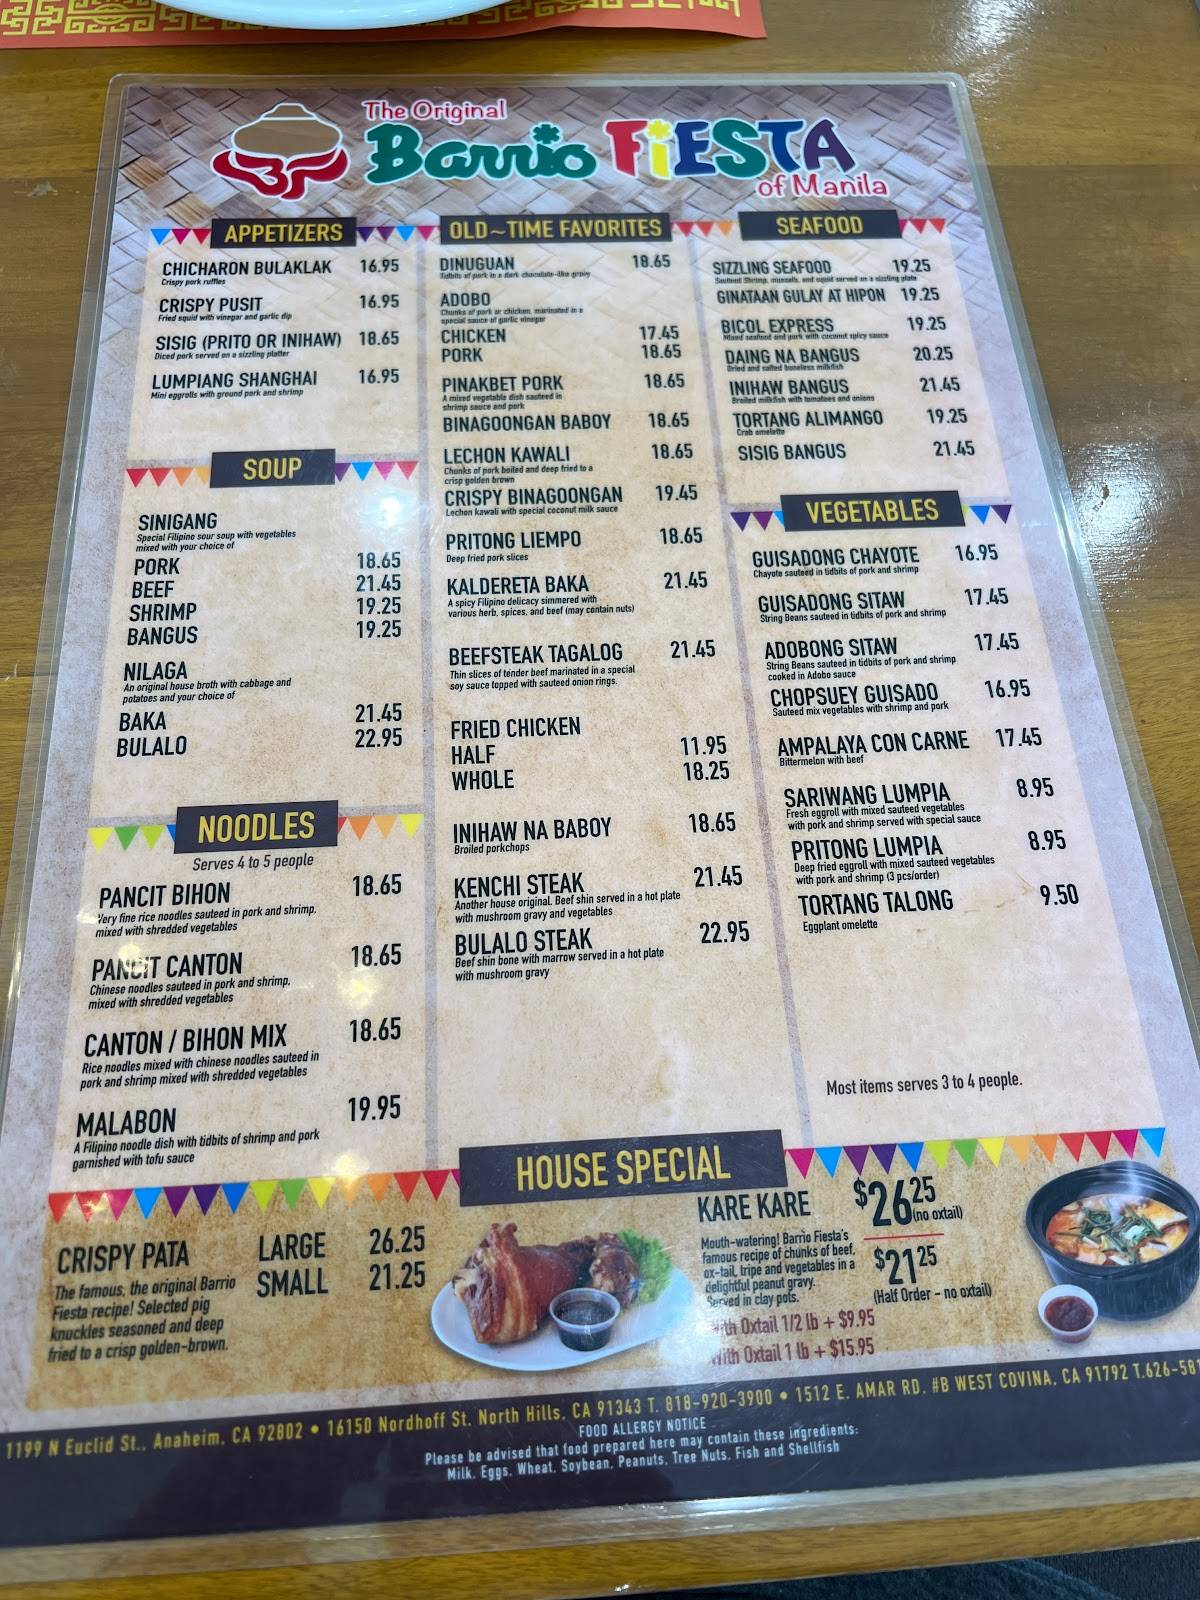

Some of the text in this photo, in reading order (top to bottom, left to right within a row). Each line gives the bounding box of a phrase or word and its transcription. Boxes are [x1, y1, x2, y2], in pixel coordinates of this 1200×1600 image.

[364, 100, 506, 123] The Original
[367, 123, 597, 184] Barrio
[758, 173, 888, 196] of Manila
[224, 223, 342, 242] APPETIZERS
[559, 218, 661, 237] FAVORITES
[776, 216, 862, 234] SEAFOOD
[162, 260, 331, 276] CHICHARON BULAKLAK
[360, 258, 399, 272] 16.95
[440, 256, 514, 271] DINUGUAN
[632, 254, 670, 268] 18.65
[712, 260, 831, 275] SIZZLING SEAFOOD
[892, 258, 930, 272] 19.25
[161, 278, 183, 287] Crispy
[185, 278, 201, 286] pork
[159, 297, 262, 312] CRISPY PUSIT
[360, 294, 399, 308] 16.95
[155, 332, 341, 351] SISIG (PRITO OR INIHAW)
[442, 375, 563, 392] PINAKBET PORK
[644, 373, 684, 388] 18.65
[729, 378, 848, 396] INIHAW BANGUS
[919, 376, 960, 392] 21.45
[736, 427, 785, 436] Crab omelette
[243, 457, 301, 480] SOUP
[445, 486, 622, 506] CRISPY BINAGOONGAN
[655, 484, 697, 501] 19.45
[445, 508, 472, 516] Lechon
[474, 507, 499, 515] kawali
[500, 507, 516, 515] with
[518, 506, 545, 516] special
[547, 505, 576, 514] coconut
[578, 504, 594, 513] milk
[805, 498, 938, 523] VEGETABLES
[138, 512, 217, 530] SINIGANG
[135, 541, 234, 552] mixed with your choice of
[955, 543, 998, 561] 16.95
[134, 557, 179, 575] PORK
[357, 551, 400, 568] 18.65
[752, 546, 919, 567] GUISADONG CHAYOTE
[449, 642, 622, 665] BEEFSTEAK TAGALOG
[670, 639, 715, 658] 21.45
[116, 735, 186, 757] BULALO
[355, 727, 402, 748] 22.95
[778, 730, 970, 756] AMPALAYA CON CARNE
[995, 727, 1042, 747] 17.45
[779, 754, 863, 766] Bittermelon with beef
[198, 811, 314, 843] NOODLES
[454, 842, 529, 855] Broiled porkchops
[192, 852, 313, 871] Serves 4 to 5 people
[352, 873, 401, 896] 18.65
[1039, 883, 1078, 905] 9.50
[99, 882, 230, 908] PANCIT BIHON
[797, 889, 953, 916] TORTANG TALONG
[803, 918, 877, 933] Eggplant omelette
[349, 1016, 400, 1042] 18.65
[84, 1023, 286, 1057] CANTON / BIHON MIX
[826, 1071, 1022, 1095] Most items serves 3 to 4 people.
[72, 1152, 194, 1172] garnished with tofu sauce
[517, 1145, 731, 1191] HOUSE SPECIAL
[697, 1190, 810, 1222] KARE KARE
[913, 1205, 962, 1222] (no oxtail)
[258, 1231, 325, 1261] LARGE
[369, 1225, 424, 1254] 26.25
[57, 1240, 189, 1274] CRISPY PATA
[705, 1276, 815, 1295] delightful peanut gravy.
[47, 1337, 228, 1362] fried to a crisp golden-brown.
[7, 1440, 42, 1458] 1199
[48, 1439, 58, 1456] N
[65, 1436, 114, 1455] Euclid
[232, 1426, 250, 1443] CA
[258, 1421, 302, 1441] 92802
[327, 1416, 371, 1436] 16150
[378, 1411, 445, 1432] Nordhoff
[451, 1410, 471, 1427] St.
[478, 1406, 518, 1425] North
[572, 1401, 590, 1418] CA
[597, 1398, 640, 1416] 91343
[647, 1396, 658, 1412] T.
[665, 1388, 772, 1412] 818-920-3900
[795, 1384, 830, 1402] 1512
[836, 1383, 849, 1400] E.
[856, 1380, 895, 1398] AMAR
[901, 1378, 925, 1395] RD.
[932, 1376, 948, 1392] #B
[954, 1373, 992, 1391] WEST
[1061, 1367, 1080, 1383] CA
[1085, 1364, 1128, 1382] 91792
[579, 1416, 706, 1437] FOOD ALLERGY NOTICE
